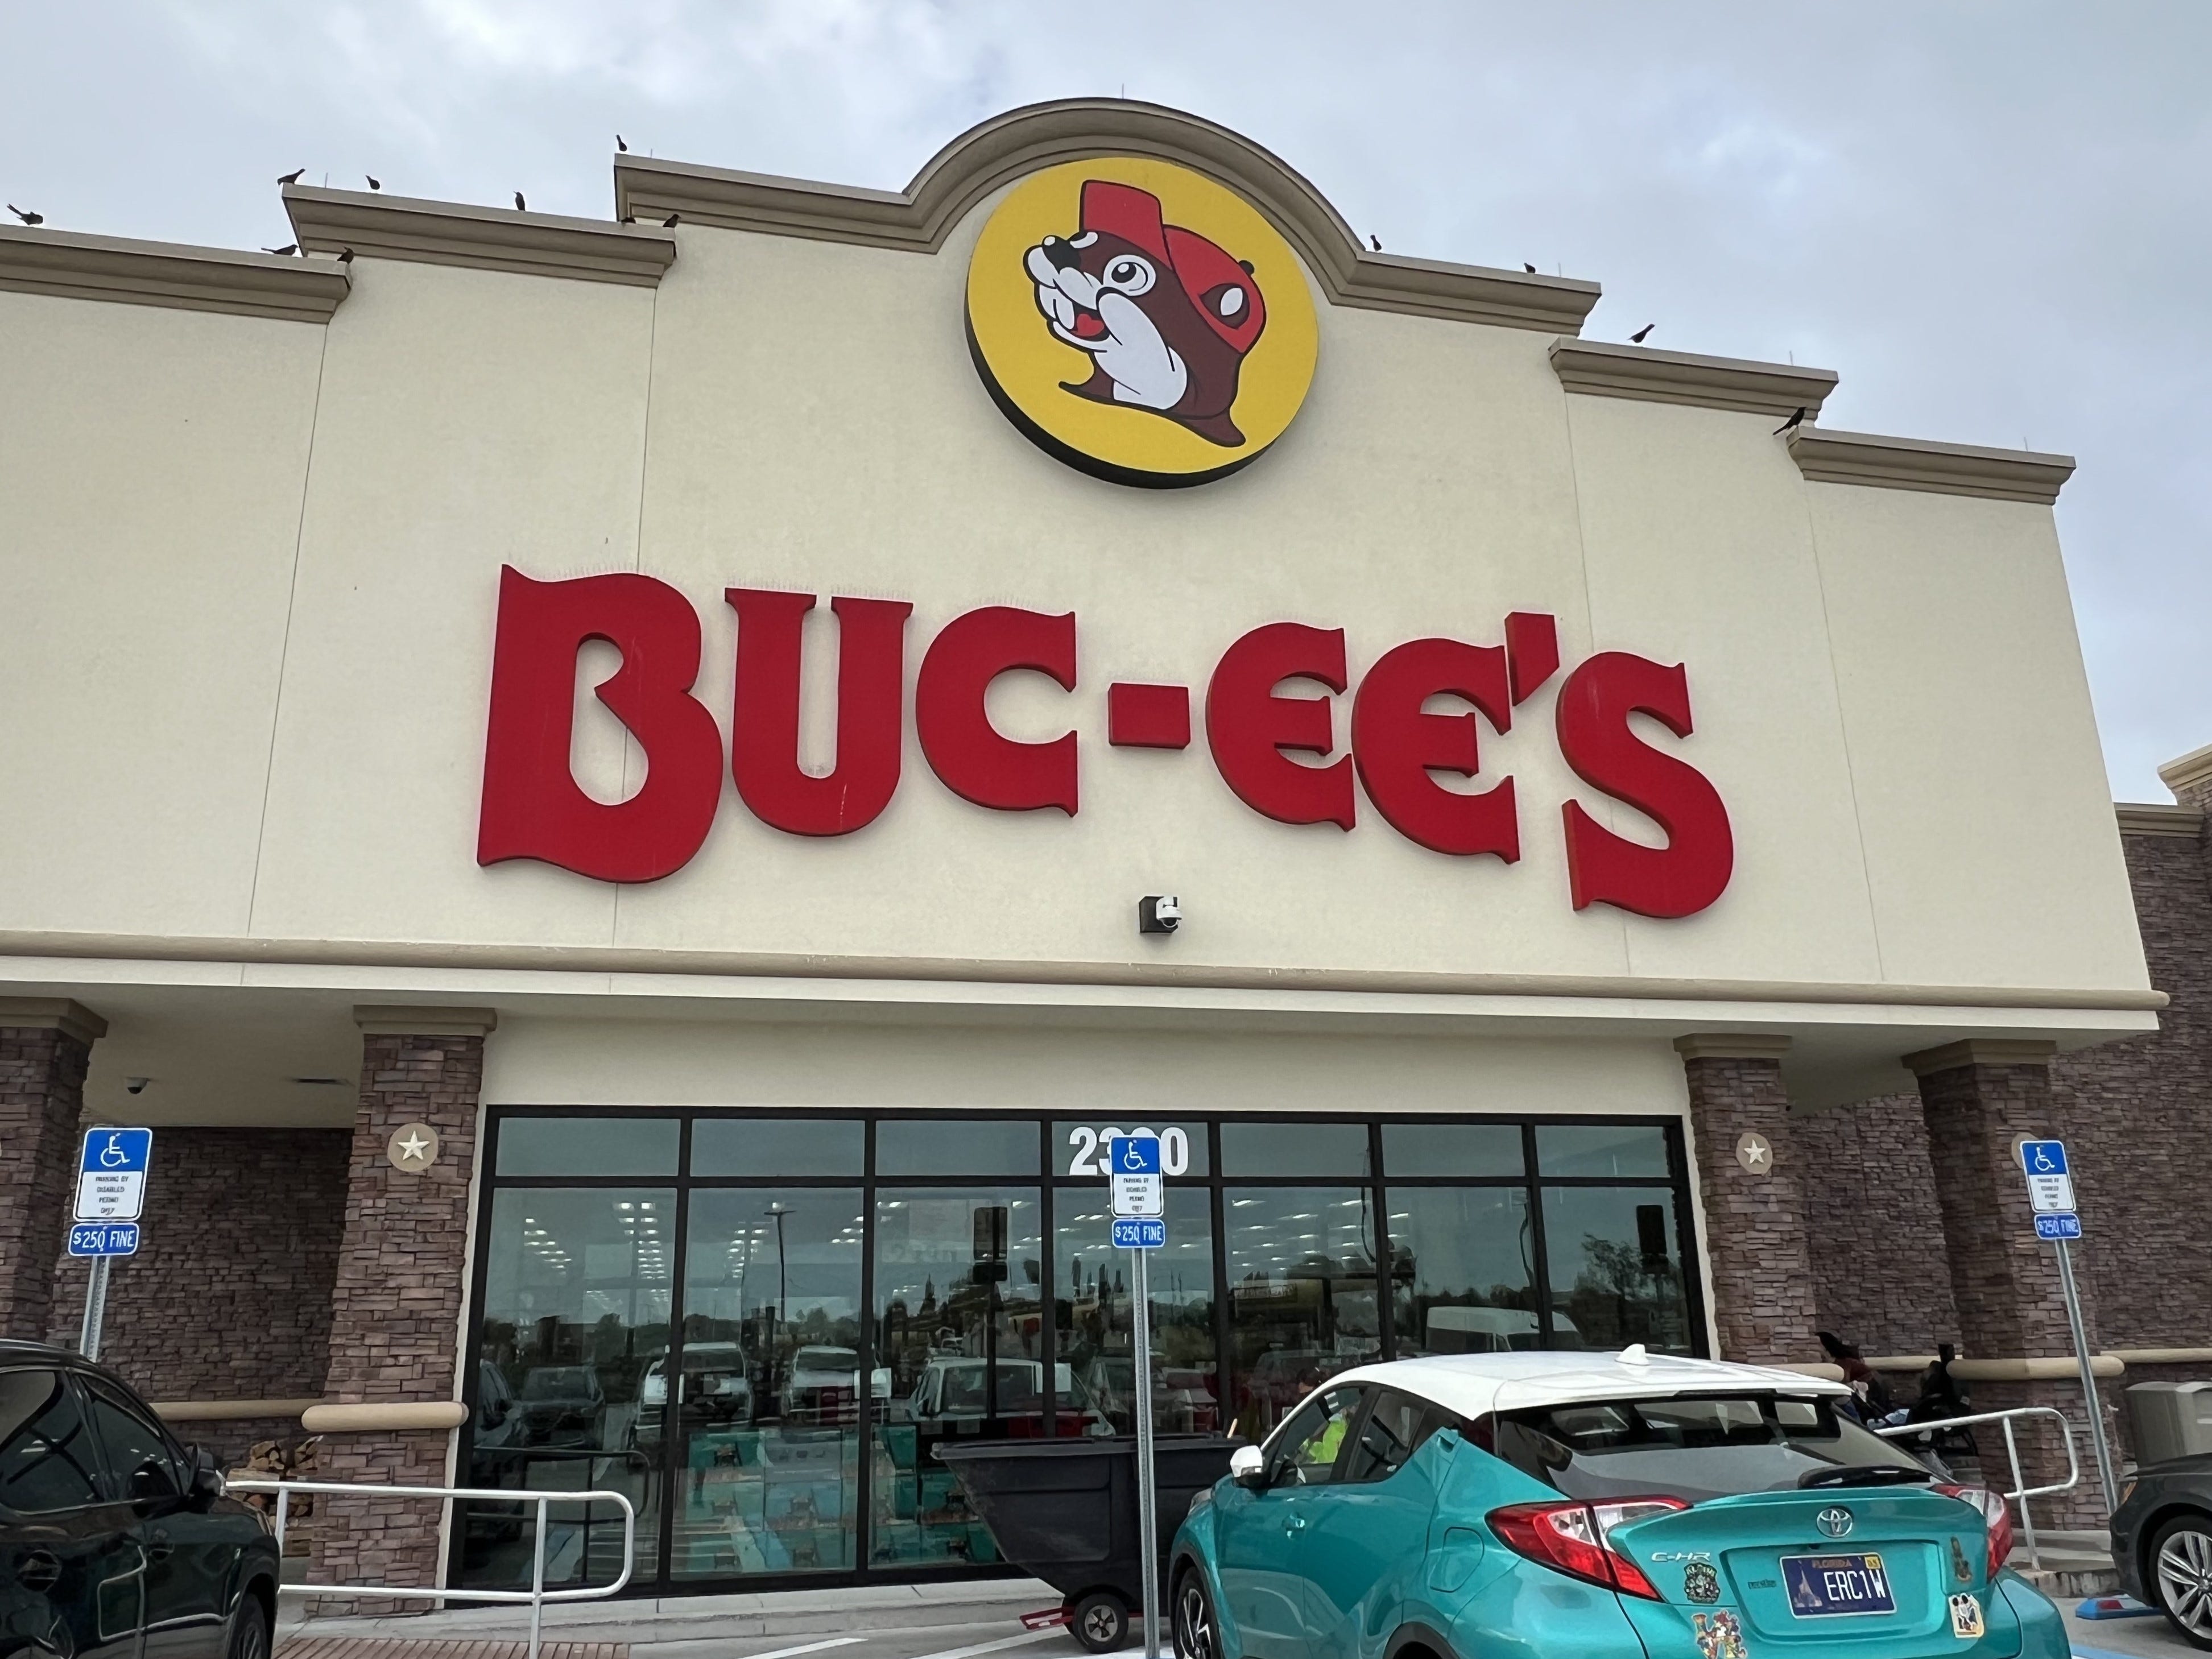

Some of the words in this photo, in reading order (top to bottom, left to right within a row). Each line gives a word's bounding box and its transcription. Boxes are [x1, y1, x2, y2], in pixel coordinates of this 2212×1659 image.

[477, 564, 1733, 919] BUC-EE'S
[1069, 1127, 1189, 1176] 230
[73, 1231, 106, 1249] $250
[110, 1230, 135, 1248] FINE
[1115, 1226, 1140, 1243] $250
[1143, 1226, 1163, 1241] FINE
[1652, 1552, 1711, 1562] C-HR
